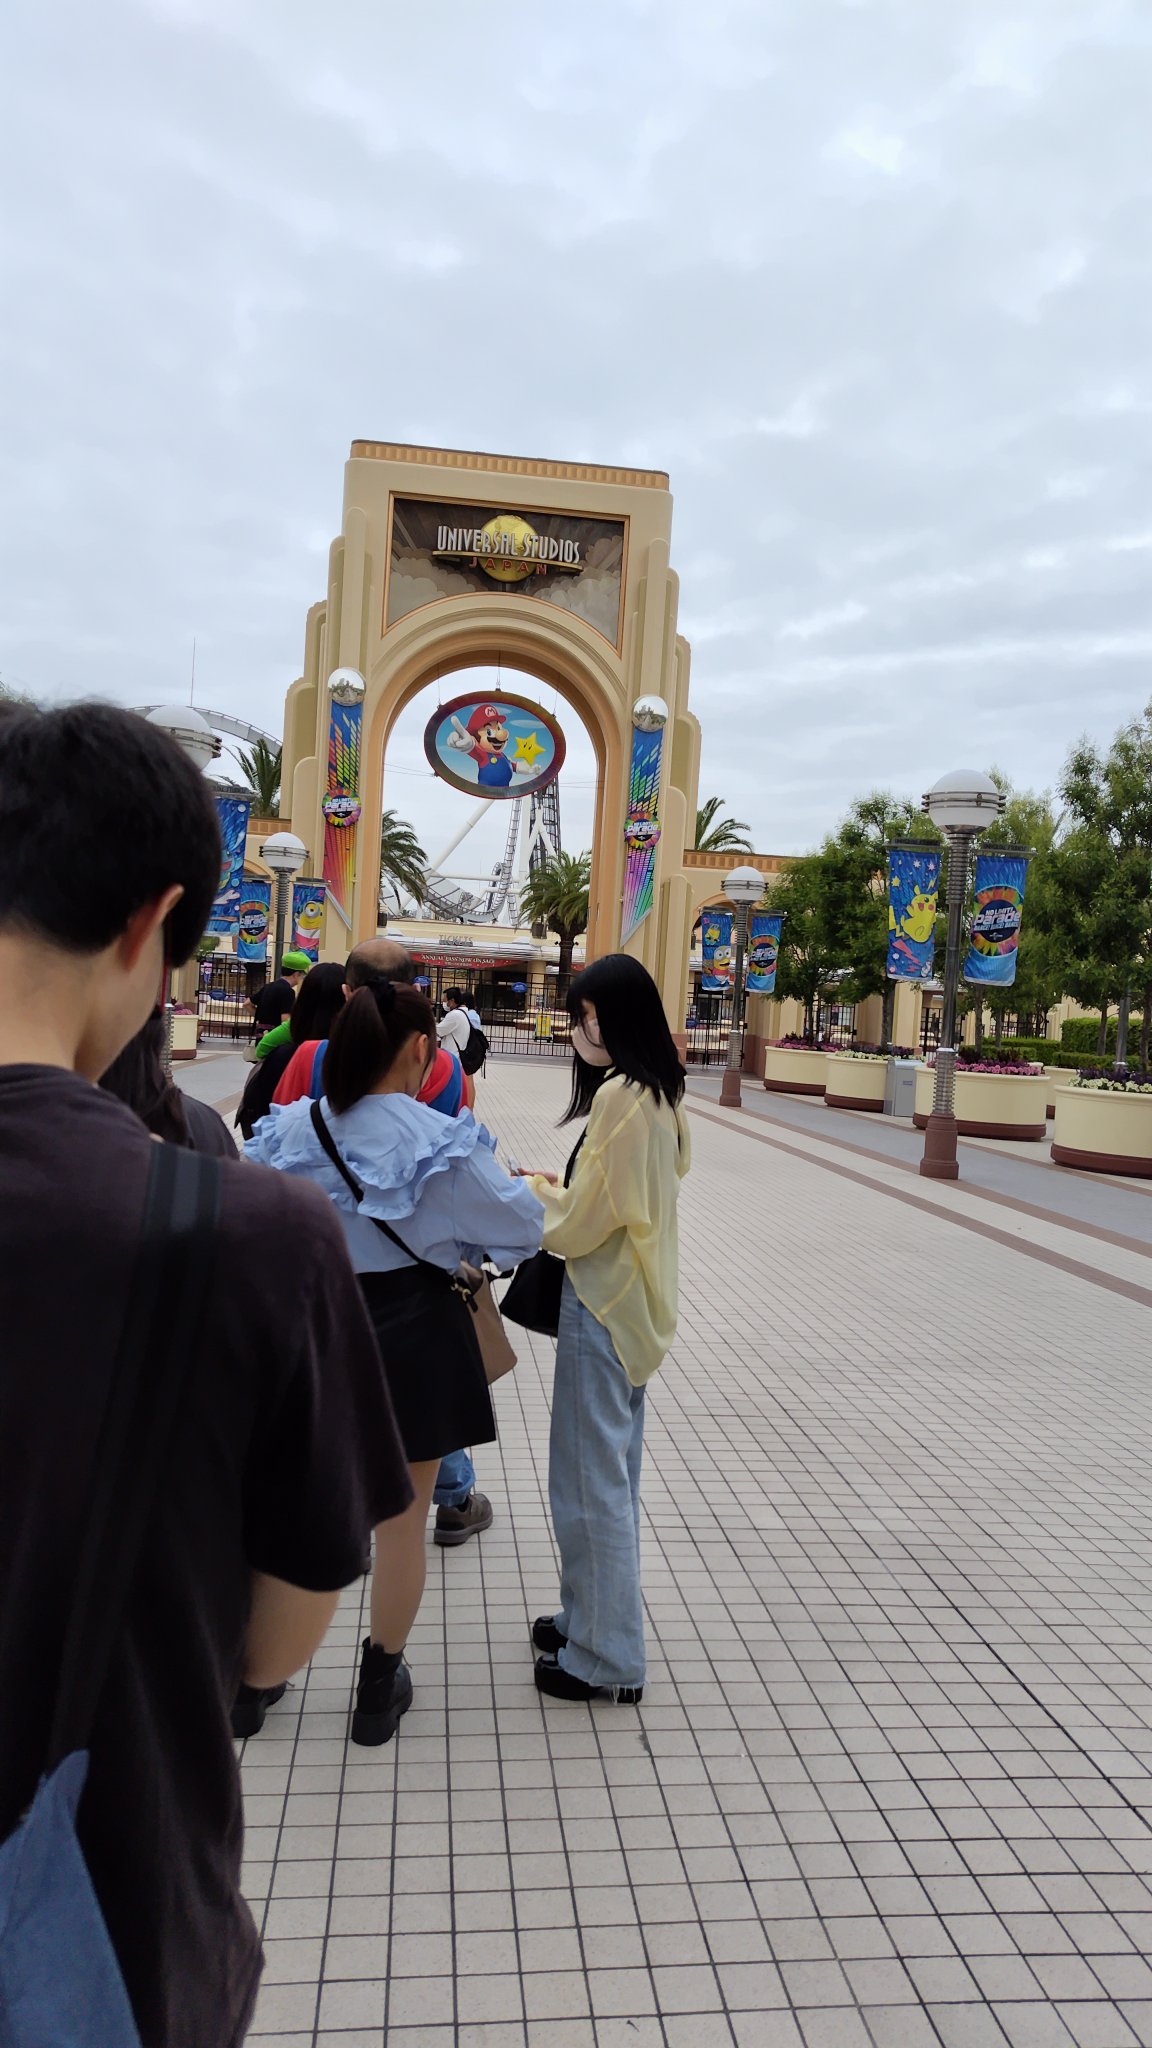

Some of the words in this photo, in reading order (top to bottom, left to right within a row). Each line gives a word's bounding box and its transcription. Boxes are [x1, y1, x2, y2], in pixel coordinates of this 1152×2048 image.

[437, 525, 519, 556] UNIVERSAL
[522, 532, 580, 564] STUDIOS
[469, 556, 548, 575] JAPAN
[973, 911, 1020, 926] Parade
[438, 934, 474, 945] TICKETS
